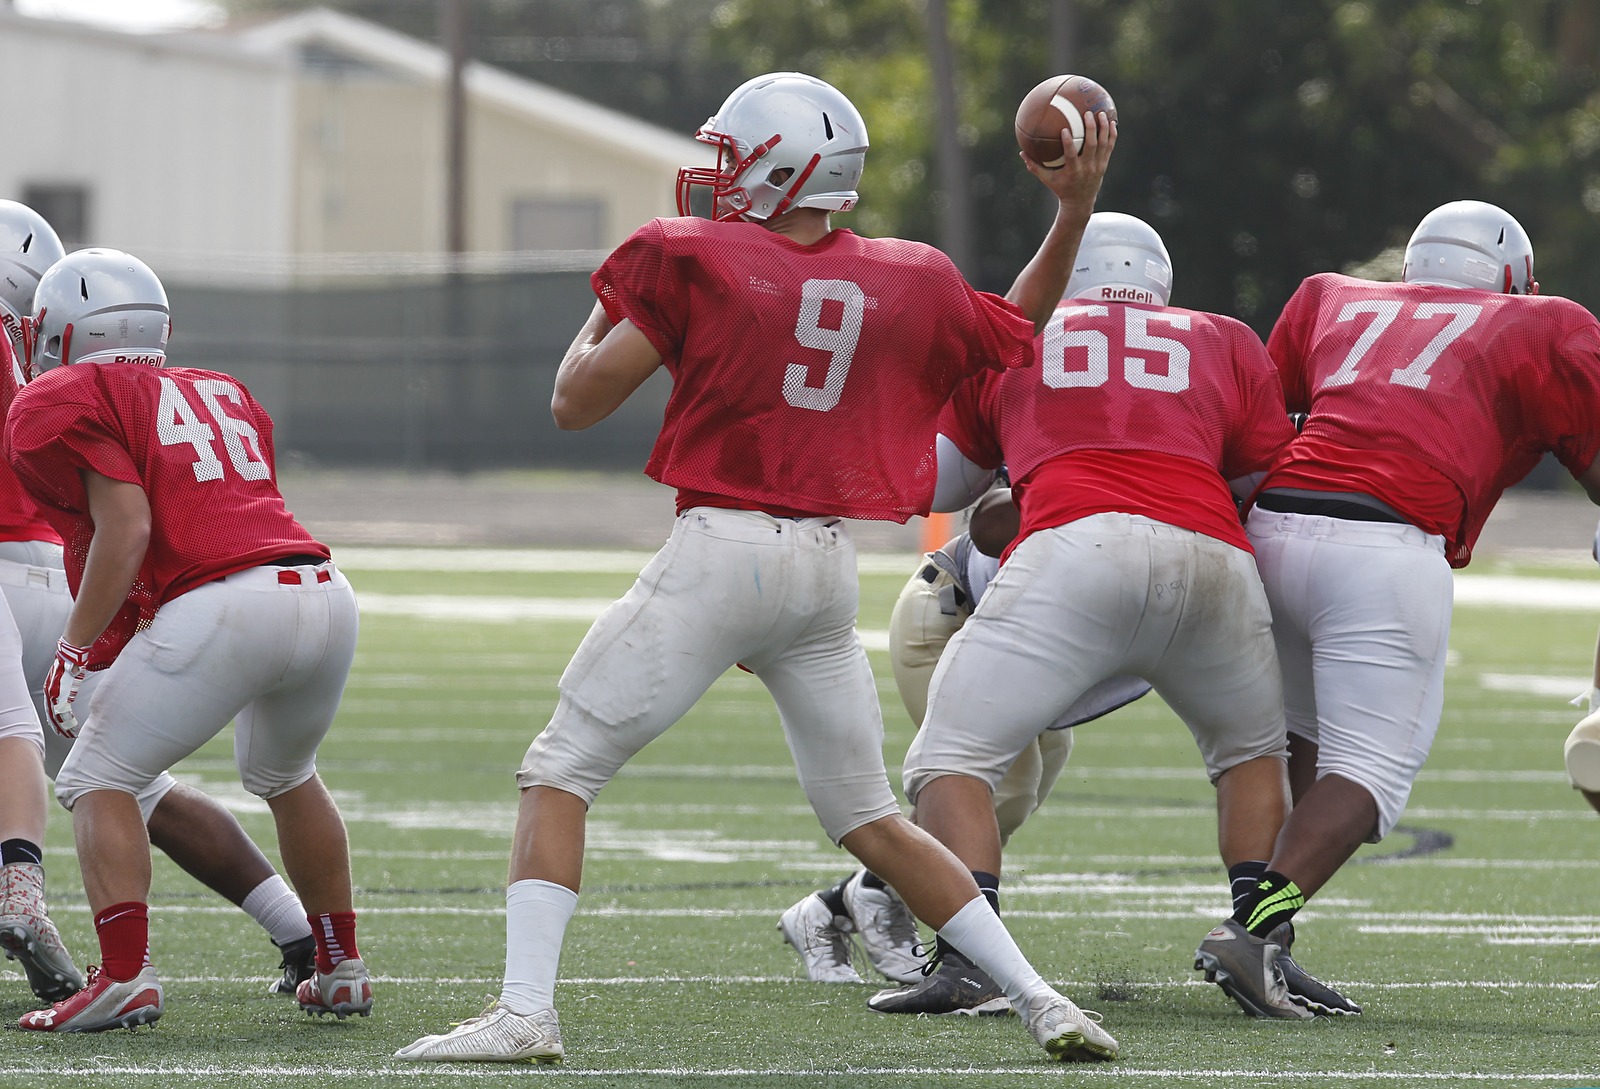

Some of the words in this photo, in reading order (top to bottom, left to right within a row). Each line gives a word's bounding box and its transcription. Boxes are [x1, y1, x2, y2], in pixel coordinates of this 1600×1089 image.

[1101, 287, 1153, 304] Riddell
[782, 278, 865, 412] 9
[1042, 304, 1192, 394] 65
[1320, 299, 1484, 391] 77
[156, 375, 271, 483] 46
